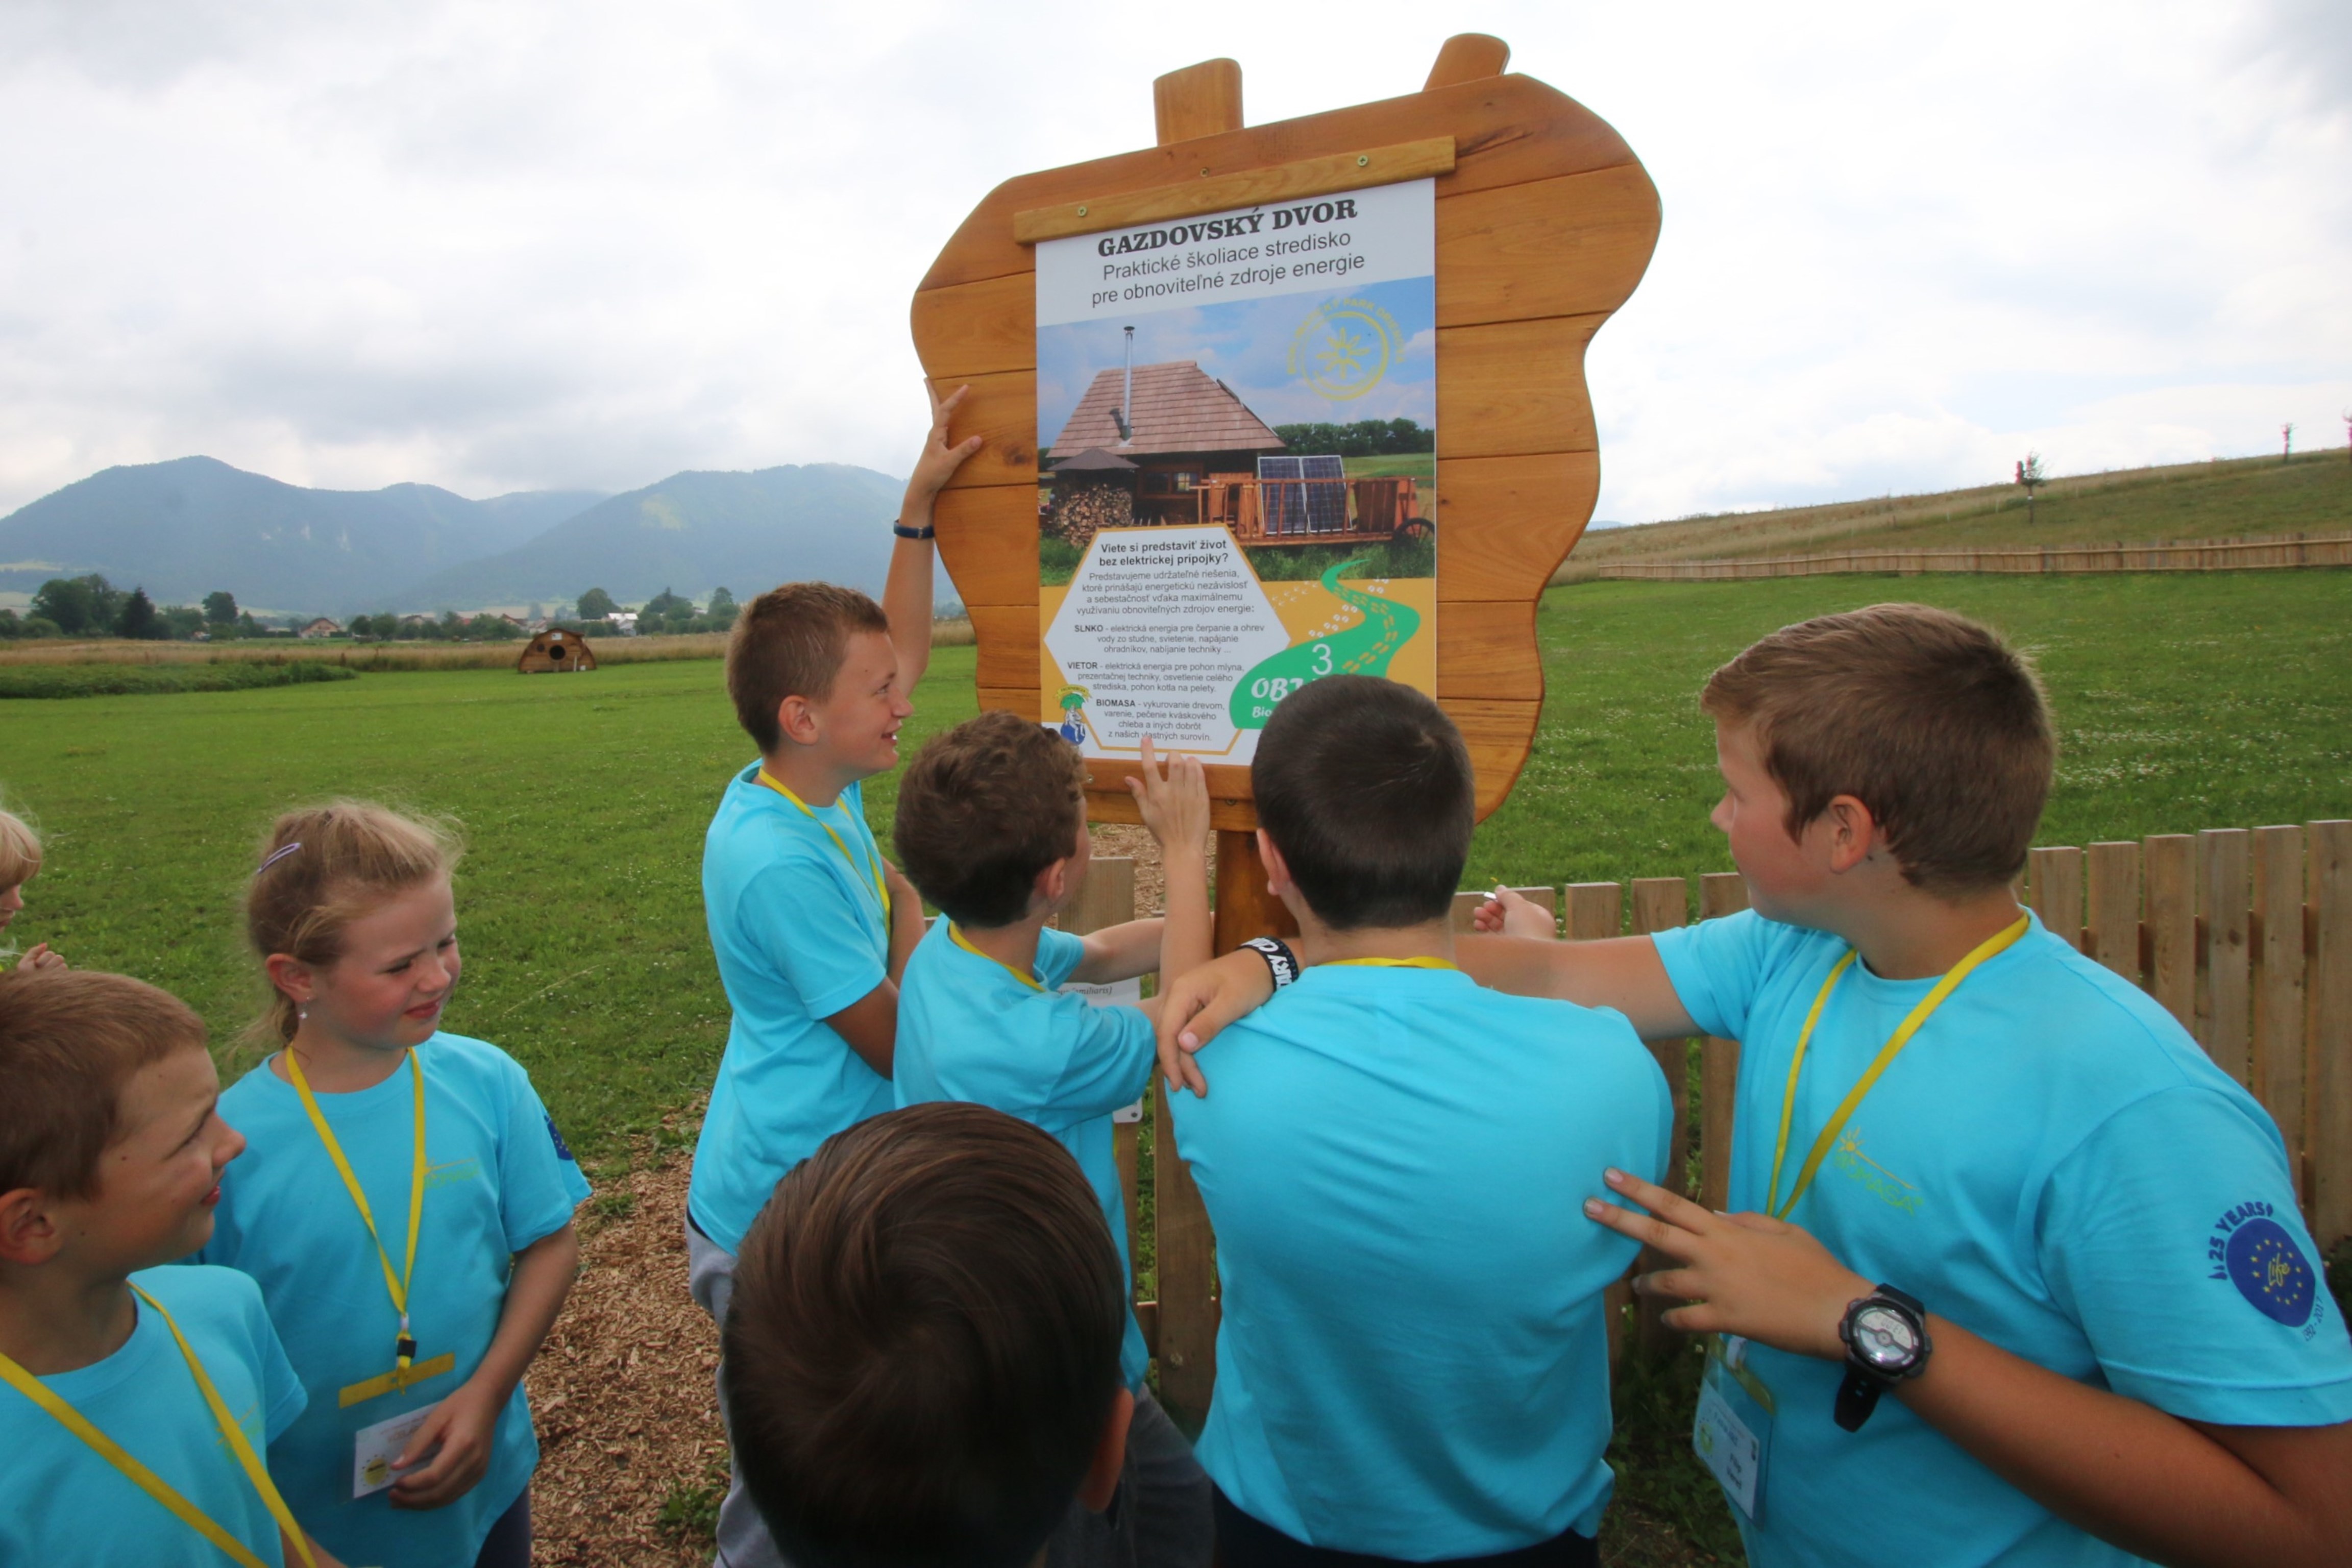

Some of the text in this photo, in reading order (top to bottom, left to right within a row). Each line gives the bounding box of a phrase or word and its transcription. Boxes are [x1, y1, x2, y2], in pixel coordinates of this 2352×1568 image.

[1098, 199, 1357, 256] GAZDOVSKÝ DVOR
[1104, 231, 1352, 280] Praktické školiace stredisko
[1093, 253, 1364, 308] pre obnoviteľné zdroje energie
[1101, 540, 1227, 554] Viete si predstaviť život
[1099, 557, 1117, 566] bez
[1120, 555, 1173, 566] elektrickej
[1089, 572, 1151, 582] Predstavujeme
[1181, 593, 1243, 601] maximálnemu
[1183, 604, 1215, 615] zdrojov
[1217, 604, 1254, 615] energie:
[1148, 624, 1178, 634] energia
[1097, 635, 1115, 644] vody
[1188, 645, 1221, 655] techniky
[1312, 643, 1332, 675] 3
[1143, 663, 1172, 672] energia
[1190, 663, 1215, 672] pohon
[1077, 672, 1125, 682] prezentačnej
[1163, 673, 1204, 681] osvetlenie
[1131, 683, 1155, 692] pohon
[1096, 699, 1136, 707] BIOMASA
[1143, 700, 1190, 709] vykurovanie
[1136, 710, 1167, 719] pečenie
[1153, 721, 1173, 731] iných
[2208, 1201, 2265, 1261] 25 YEARS
